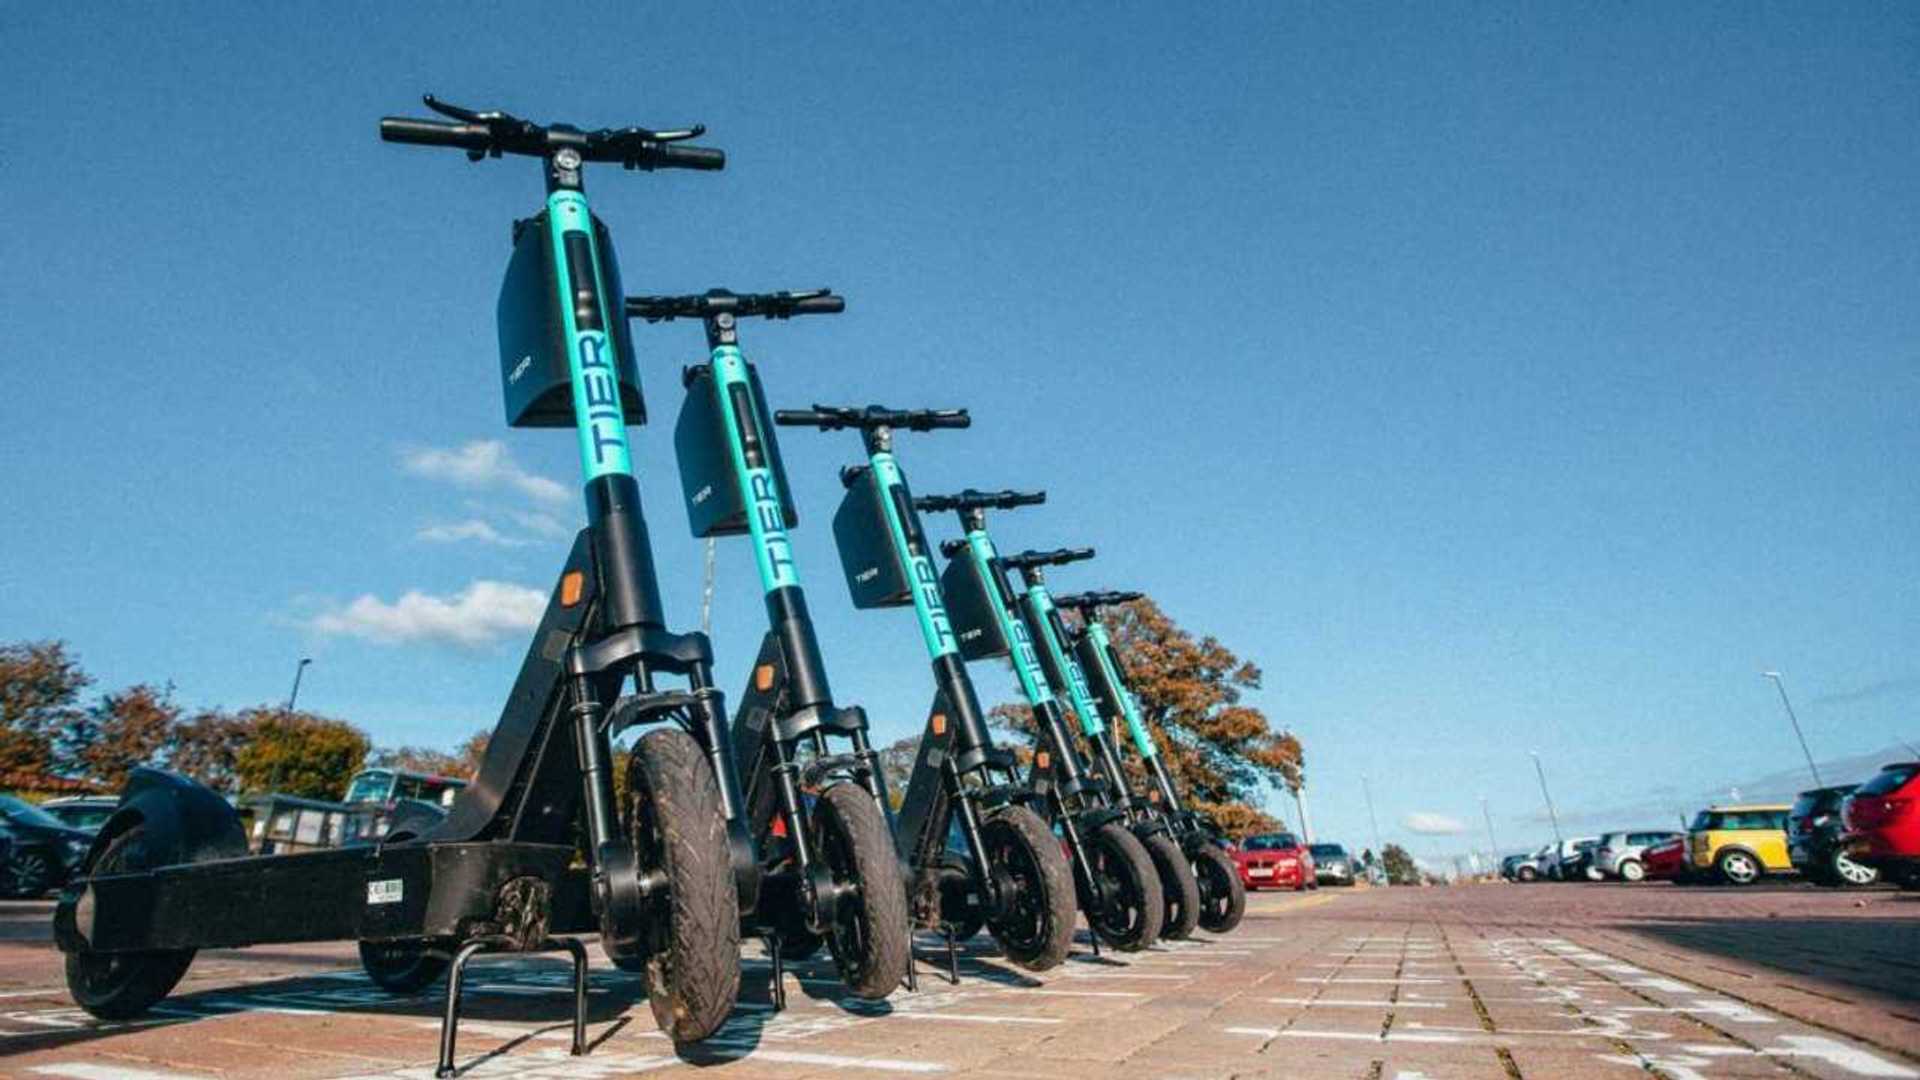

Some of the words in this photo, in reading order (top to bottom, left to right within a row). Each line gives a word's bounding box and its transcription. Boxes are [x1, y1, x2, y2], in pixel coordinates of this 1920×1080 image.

[579, 336, 623, 464] TIER
[752, 474, 792, 579] TIER
[915, 561, 952, 647] TIER
[1014, 621, 1048, 698] TIER
